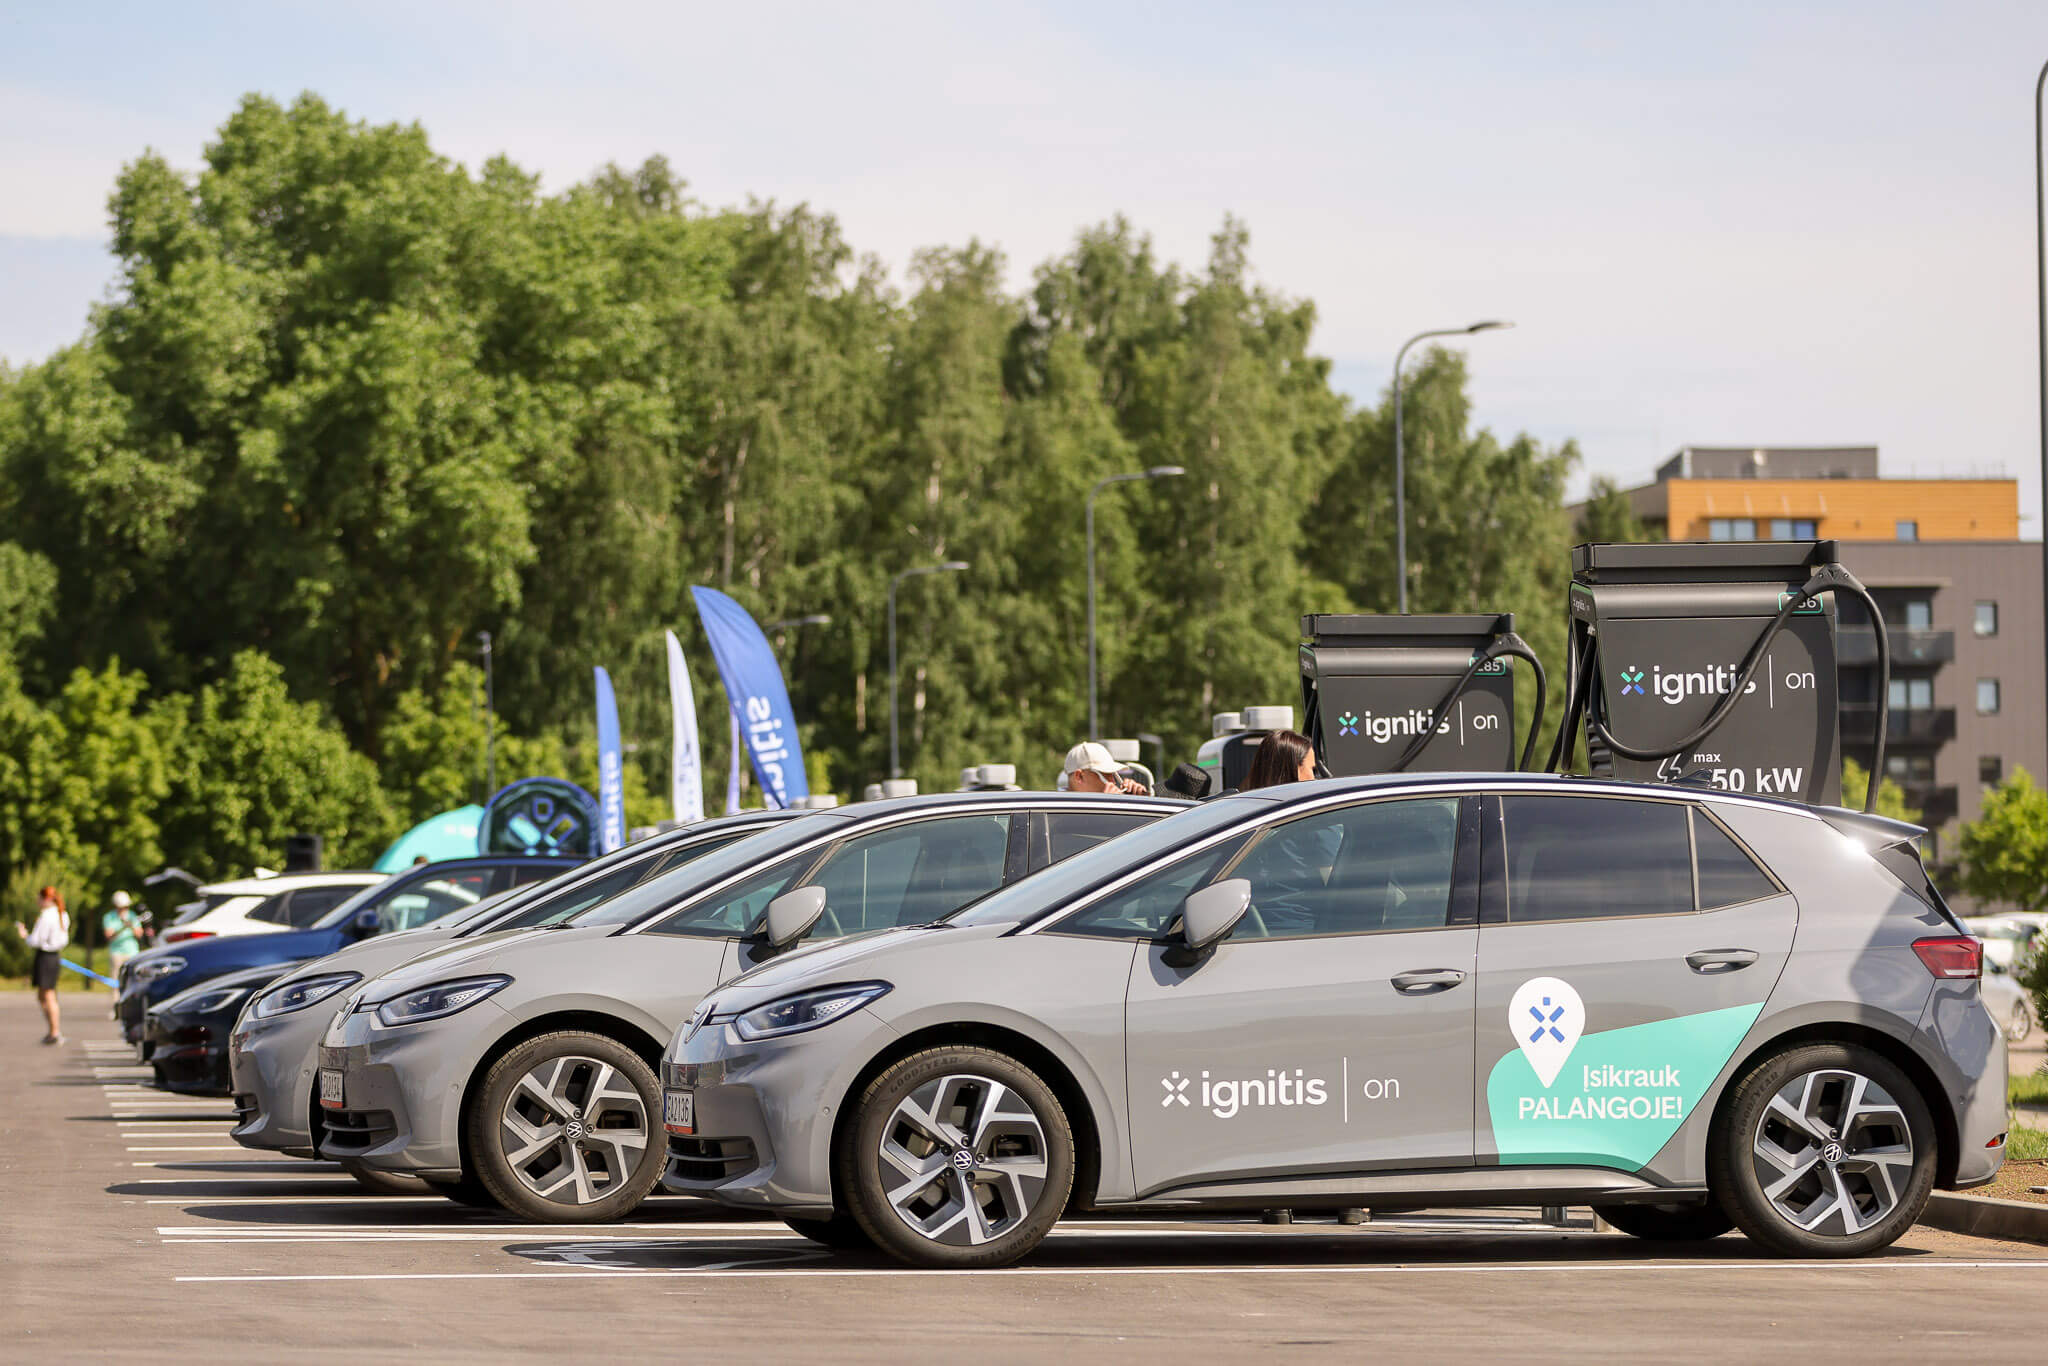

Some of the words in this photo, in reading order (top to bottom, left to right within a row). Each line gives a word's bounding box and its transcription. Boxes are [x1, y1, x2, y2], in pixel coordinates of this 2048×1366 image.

[1477, 660, 1500, 672] 85
[1785, 672, 1816, 689] on
[1473, 714, 1498, 730] on
[1693, 753, 1721, 763] max
[1708, 767, 1745, 792] 50
[1756, 768, 1803, 793] kW
[1583, 1065, 1681, 1093] Įsikrauk
[1201, 1069, 1328, 1119] ignitis
[1363, 1079, 1400, 1099] on
[1518, 1096, 1683, 1119] PALANGOJE!
